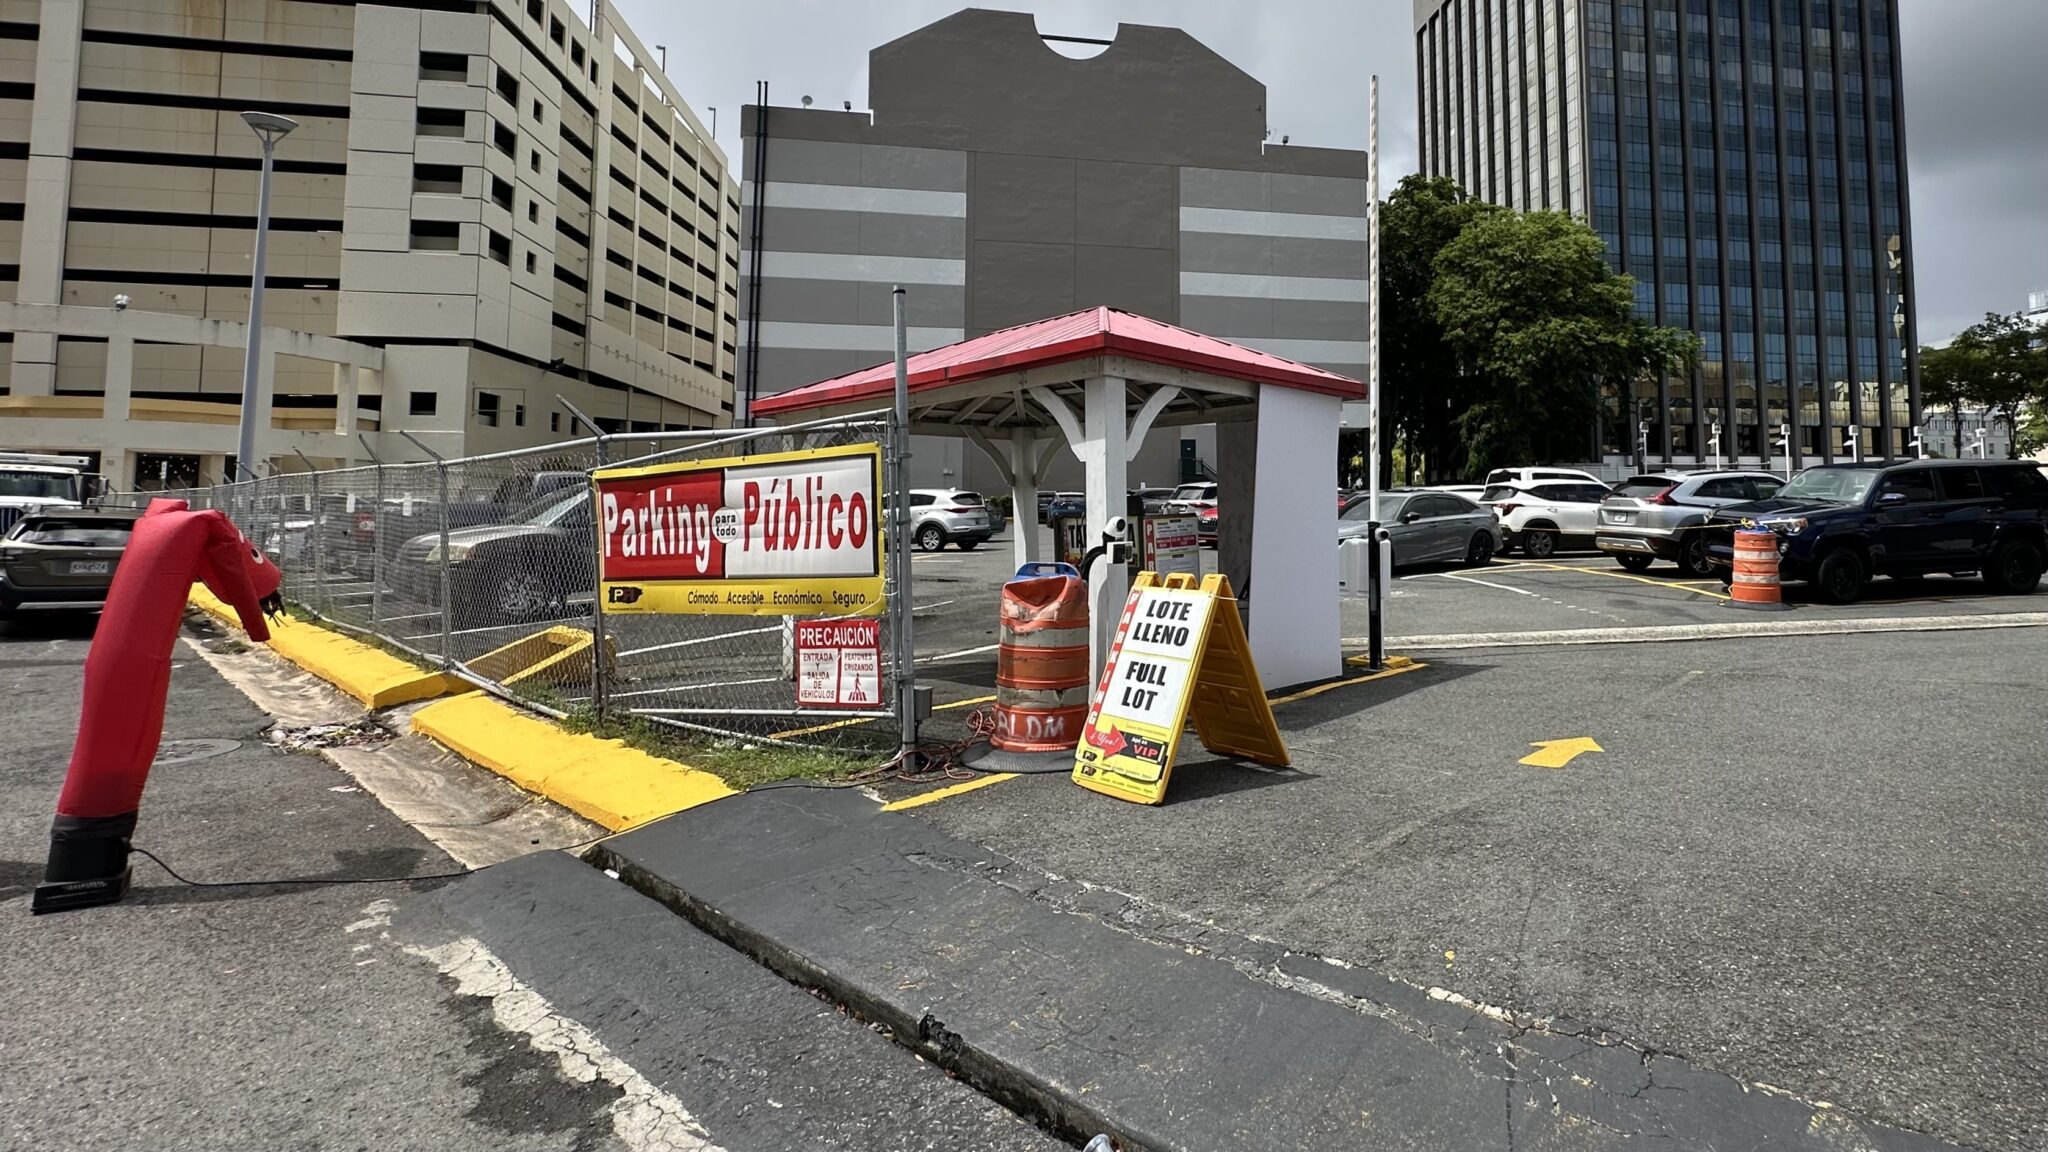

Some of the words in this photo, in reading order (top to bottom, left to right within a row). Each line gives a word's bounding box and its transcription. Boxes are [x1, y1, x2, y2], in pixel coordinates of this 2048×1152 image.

[602, 488, 711, 574] Parking
[743, 475, 868, 553] Público
[715, 514, 737, 526] para
[716, 526, 737, 537] todo
[1146, 600, 1193, 621] LOTE
[799, 622, 875, 646] PRECAUCIÓN
[1132, 622, 1190, 647] LLENO
[803, 652, 834, 662] ENTRADA
[844, 652, 873, 661] PEATONES
[1088, 591, 1140, 725] PARKING
[815, 662, 820, 671] Y
[844, 663, 874, 672] CRUZANDO
[807, 671, 830, 680] SALIDA
[1125, 661, 1167, 687] FULL
[813, 680, 822, 689] DE
[1121, 686, 1159, 711] LOT
[1134, 744, 1159, 757] VIP
